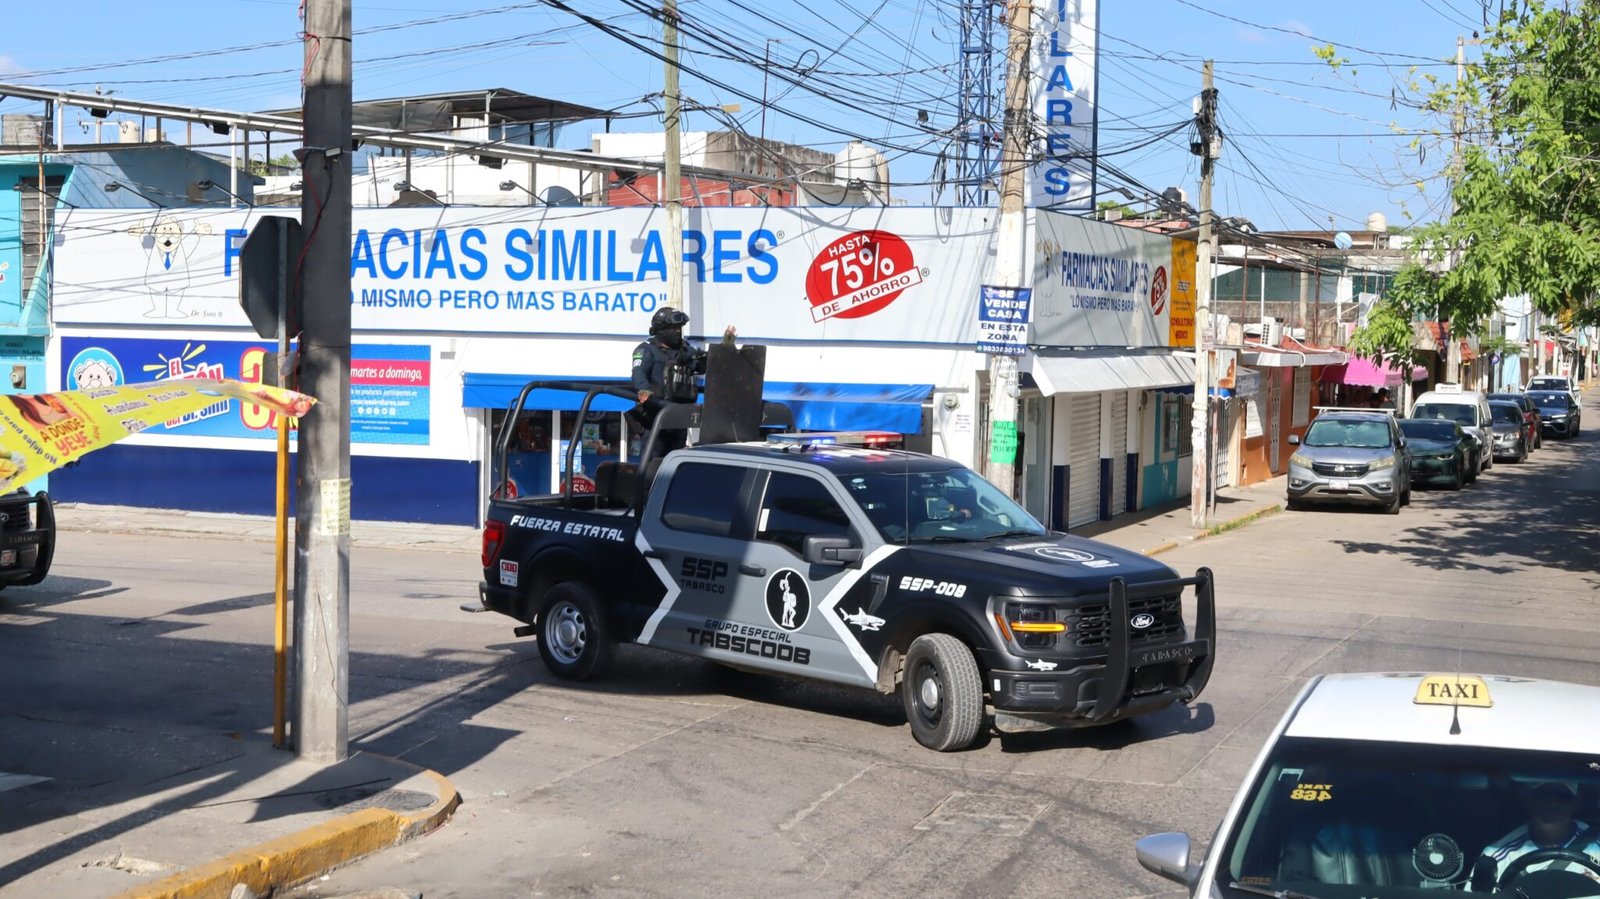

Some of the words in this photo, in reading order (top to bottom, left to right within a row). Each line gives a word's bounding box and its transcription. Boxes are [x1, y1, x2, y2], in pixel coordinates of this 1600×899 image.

[224, 228, 488, 281] FACIAS
[505, 228, 779, 285] SIMILARES
[828, 235, 871, 257] HASTA
[820, 242, 894, 297] 75%
[1061, 251, 1109, 292] FARMACIAS
[361, 289, 432, 308] MISMO
[439, 290, 500, 309] PERO
[507, 290, 555, 310] MAS
[822, 302, 841, 315] DE
[851, 275, 911, 304] AHORRO
[985, 298, 1027, 310] VENDE
[998, 290, 1015, 299] SE
[987, 309, 1022, 320] CASA
[981, 322, 996, 330] EN
[999, 323, 1026, 332] ESTA
[987, 332, 1018, 342] ZONA
[170, 360, 182, 377] EL
[350, 367, 378, 378] martes
[378, 368, 385, 378] a
[385, 366, 423, 381] domingo,
[39, 429, 51, 444] A
[49, 417, 85, 438] DONDE
[573, 484, 589, 493] 5%
[510, 515, 561, 532] FUERZA
[563, 522, 625, 542] ESTATAL
[681, 556, 729, 580] SSP
[680, 579, 725, 595] TABASCO
[899, 575, 967, 598] SSP-008
[704, 619, 739, 633] GRUPO
[740, 625, 792, 643] ESPECIAL
[1135, 615, 1150, 626] Ford
[686, 627, 811, 666] TABSCOOB
[1427, 682, 1479, 699] TAXI
